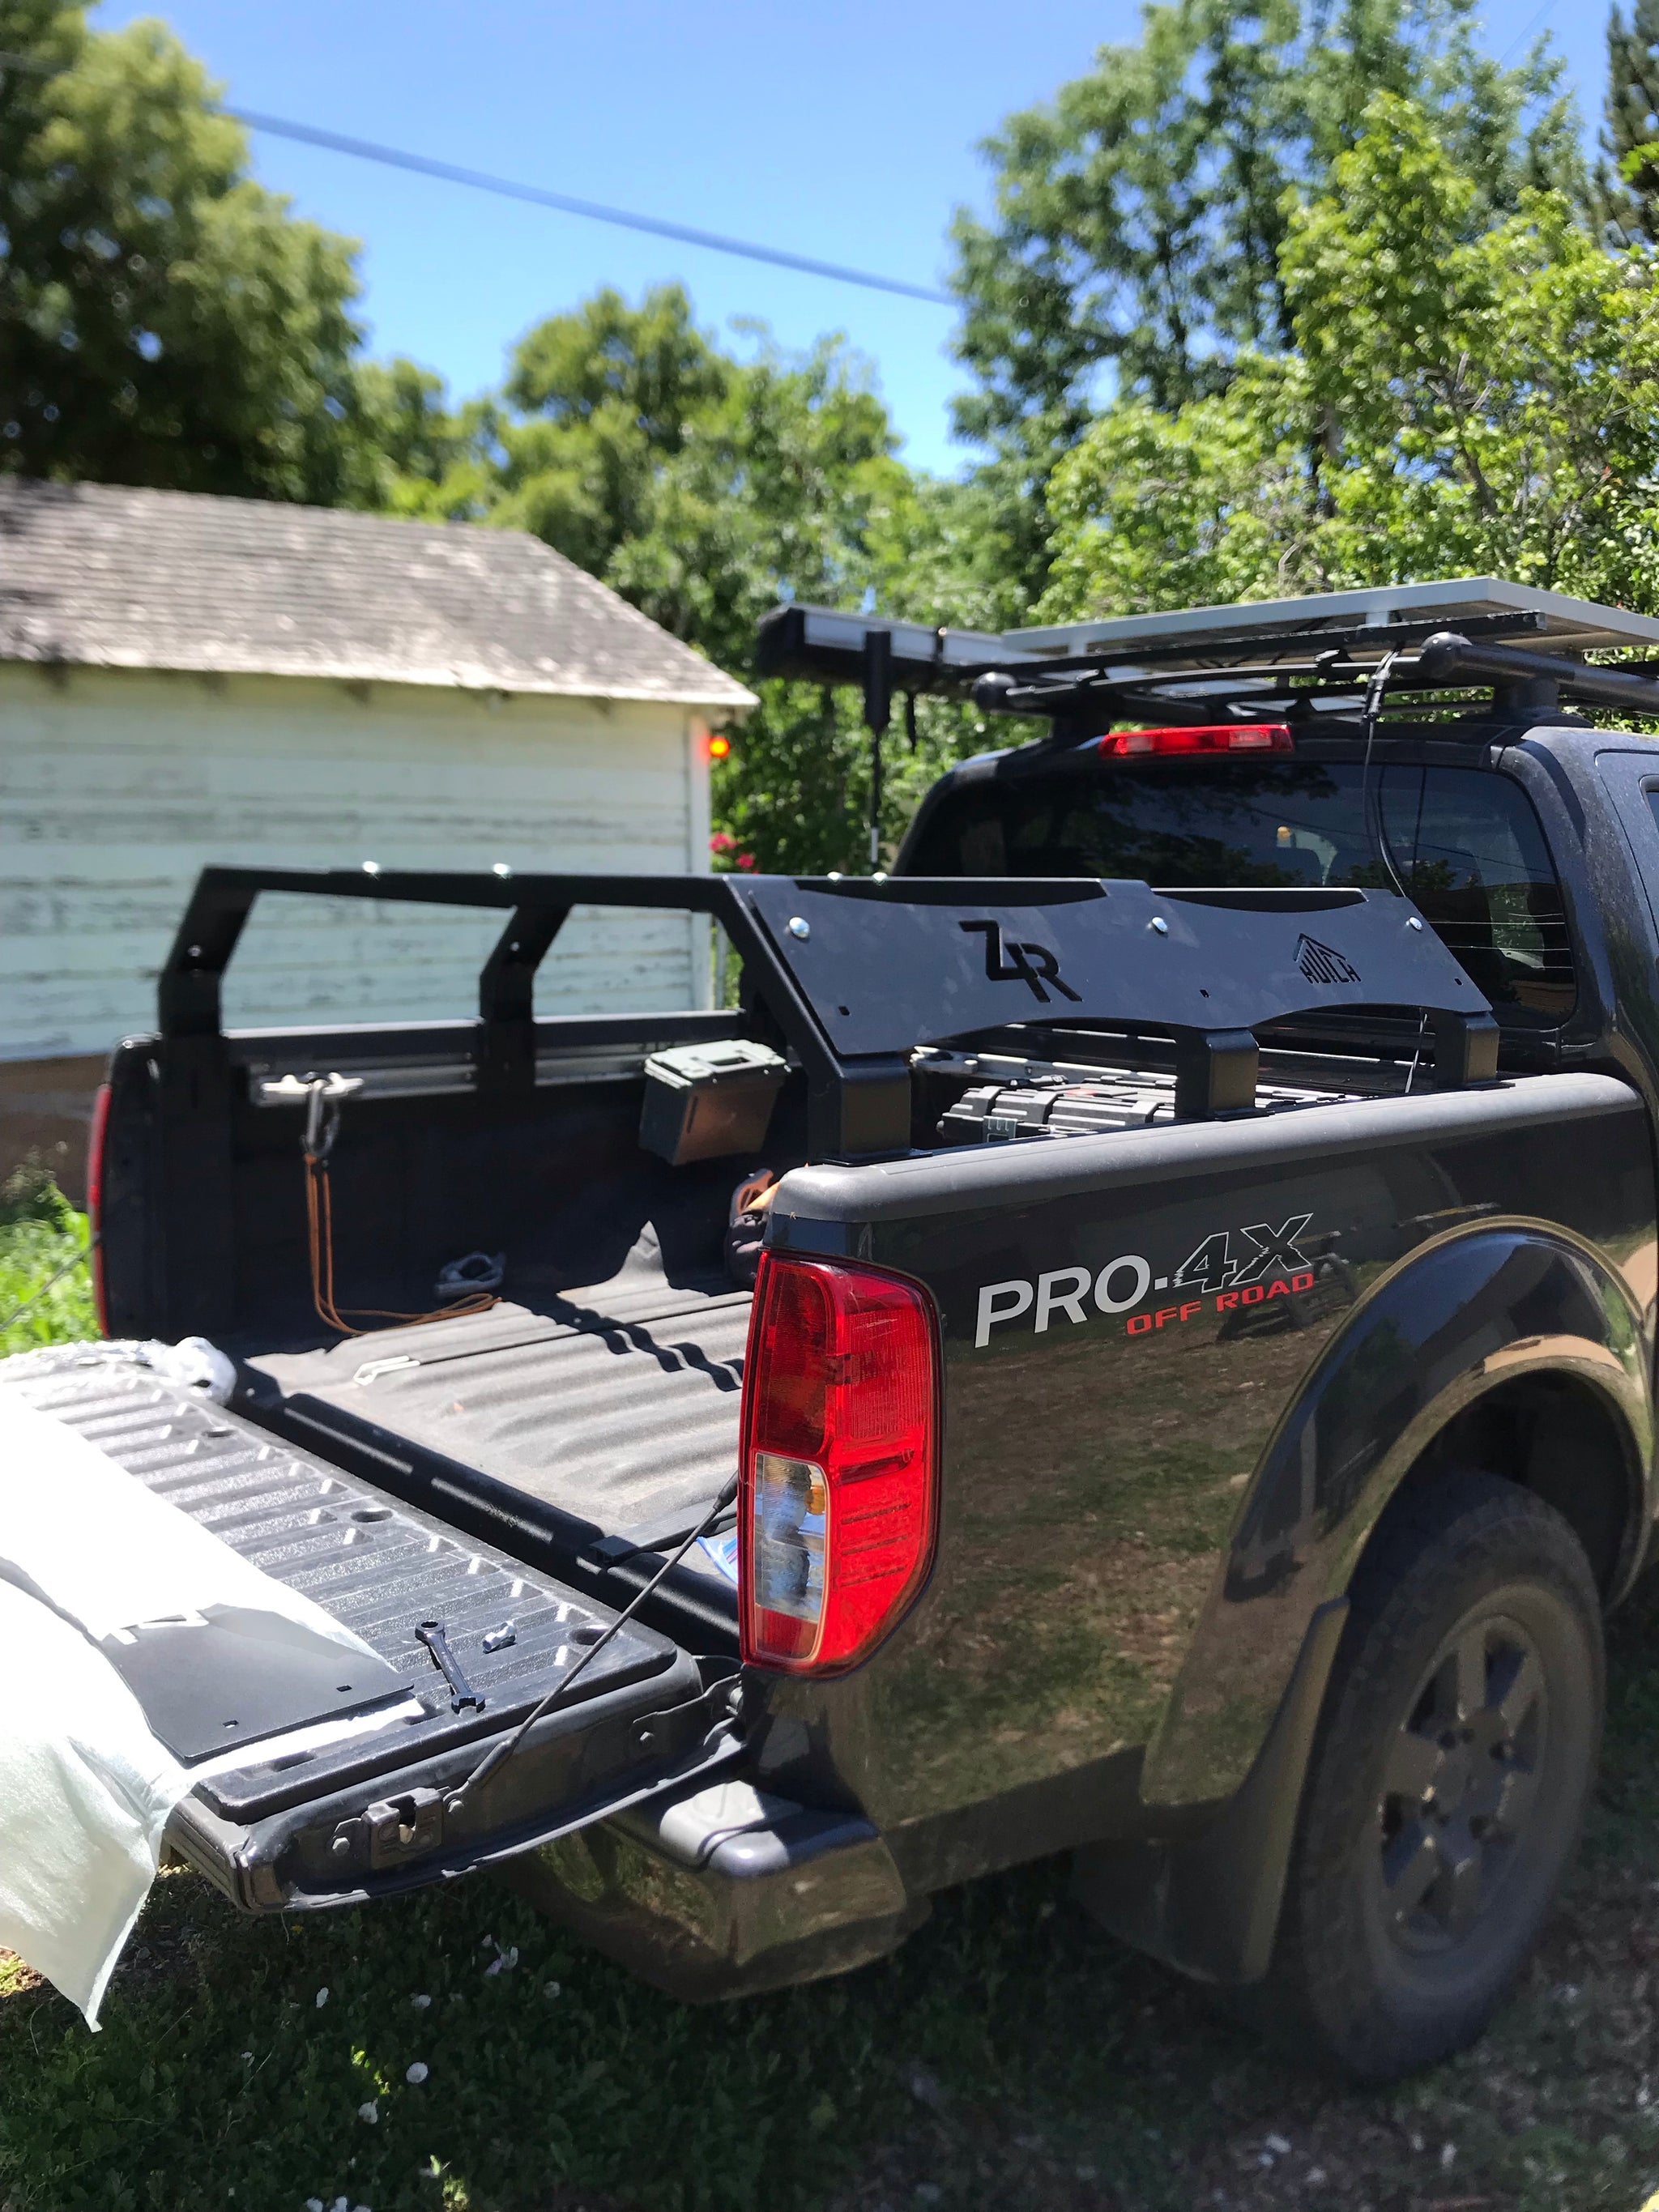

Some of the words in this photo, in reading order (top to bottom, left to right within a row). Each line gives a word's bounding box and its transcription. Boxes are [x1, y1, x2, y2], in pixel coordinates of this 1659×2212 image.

[1299, 940, 1361, 983] HUTCH
[1127, 1301, 1201, 1335] OFF
[1217, 1272, 1313, 1311] ROAD
